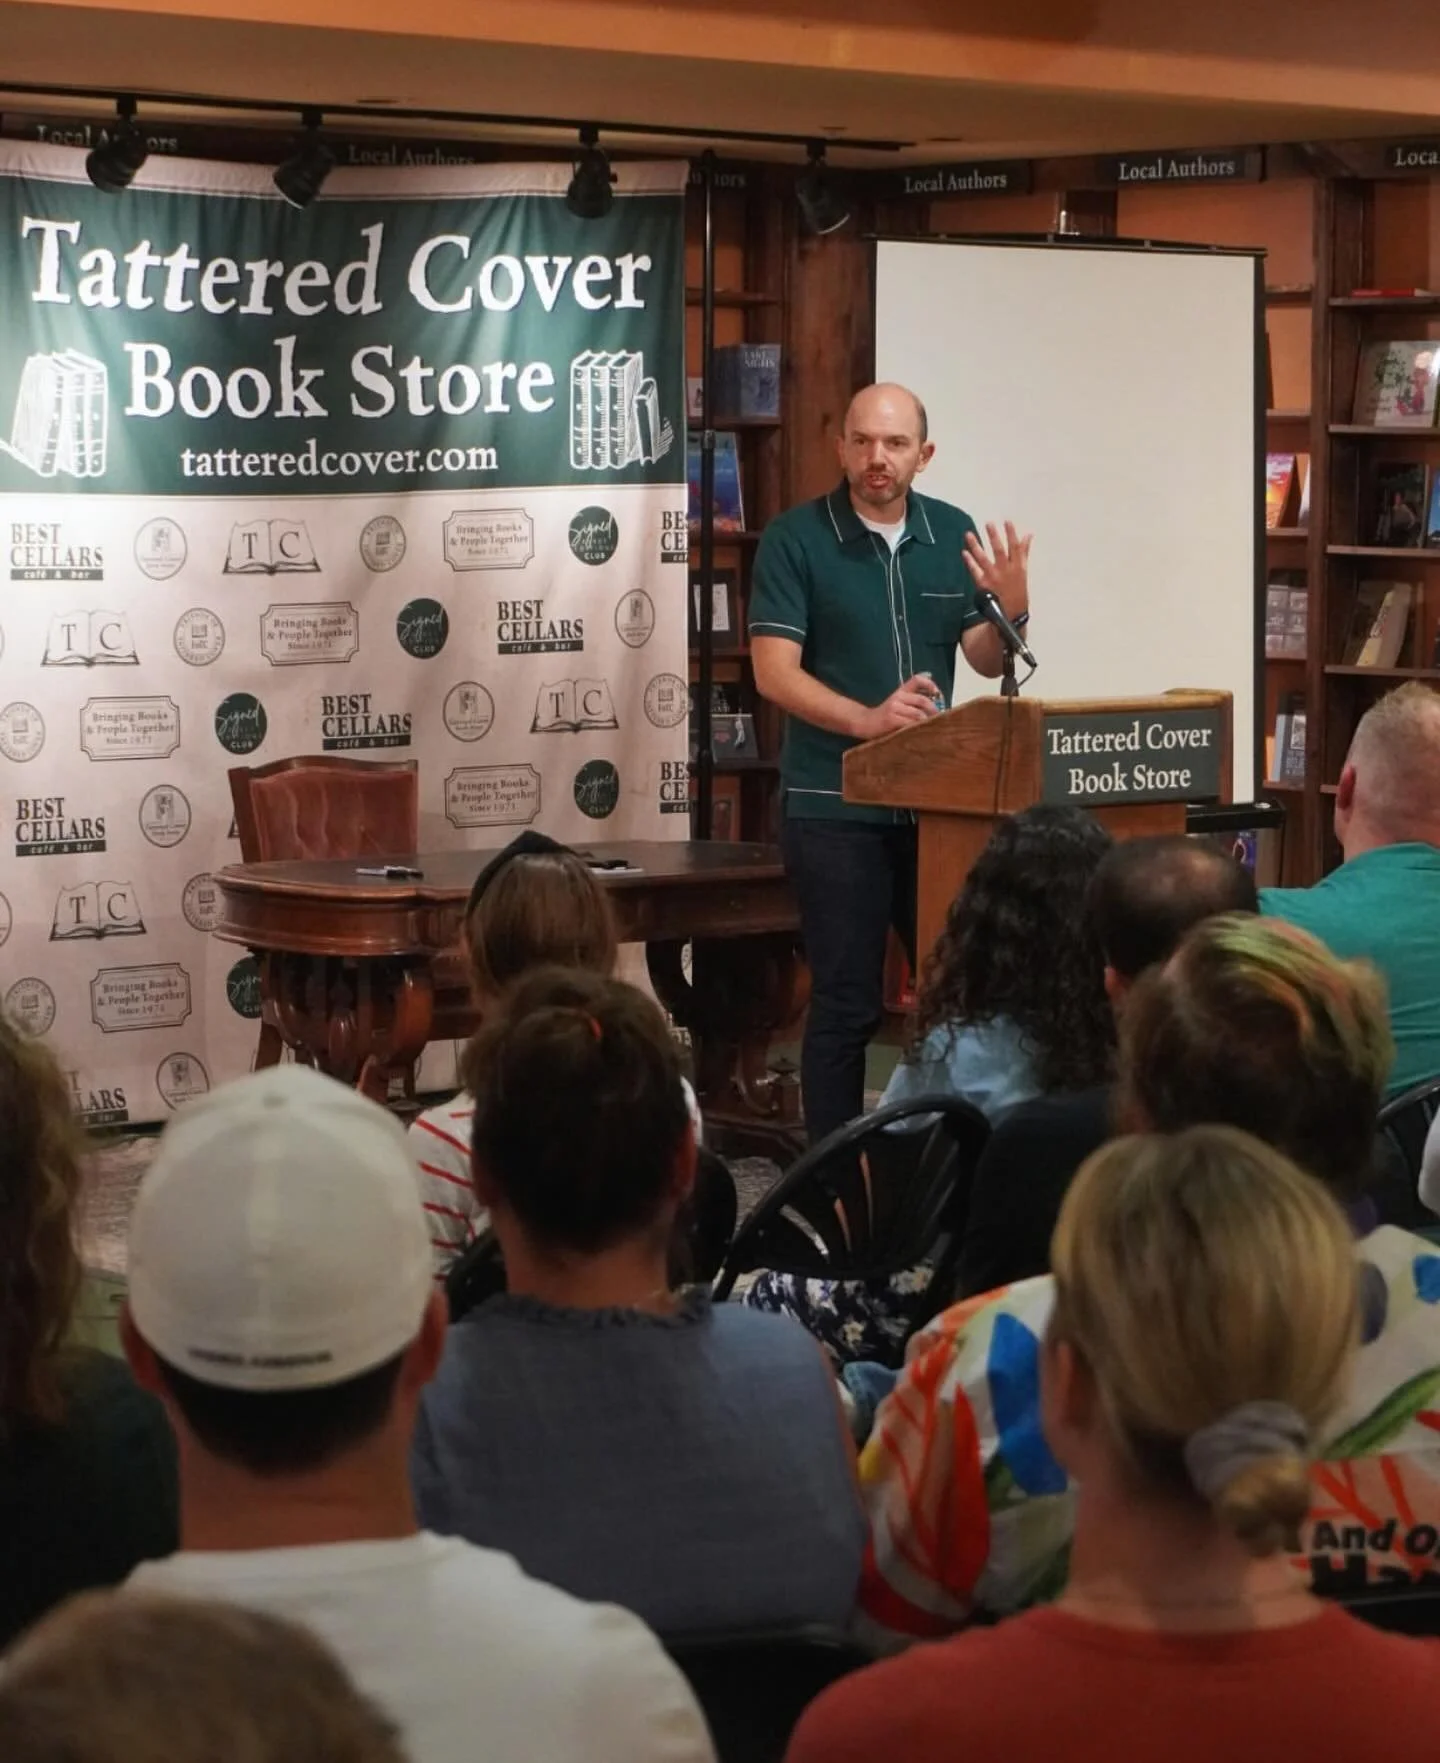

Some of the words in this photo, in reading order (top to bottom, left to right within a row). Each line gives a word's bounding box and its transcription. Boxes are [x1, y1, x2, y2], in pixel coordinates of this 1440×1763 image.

[349, 144, 397, 164] Local
[1119, 158, 1163, 180] Local
[1166, 155, 1235, 178] Authors
[905, 172, 944, 193] Local
[947, 170, 1008, 191] Authors
[21, 215, 385, 316] Tattered
[407, 235, 652, 314] Cover
[123, 335, 329, 420] Book
[350, 343, 556, 419] Store
[180, 440, 499, 478] tatteredcover.com
[11, 523, 61, 545] BEST
[456, 525, 493, 535] Bringing
[11, 547, 104, 567] CELLARS
[242, 532, 257, 560] T
[279, 531, 300, 558] C
[584, 552, 606, 560] CLUB
[497, 600, 544, 620] BEST
[274, 619, 319, 630] Bringing
[497, 619, 584, 642] CELLARS
[61, 624, 76, 651] T
[100, 623, 122, 650] C
[321, 693, 372, 716] BEST
[549, 691, 564, 718] T
[583, 689, 602, 715] C
[93, 711, 135, 723] Bringing
[321, 713, 413, 738] CELLARS
[230, 741, 253, 749] CLUB
[1047, 720, 1140, 755] Tattered
[1146, 723, 1212, 750] Cover
[456, 780, 498, 792] Bringing
[1067, 761, 1128, 795] Book
[1132, 764, 1192, 791] Store
[16, 797, 65, 821] BEST
[16, 817, 106, 842] CELLARS
[69, 895, 86, 924] T
[107, 892, 127, 920] C
[102, 982, 146, 994] Bringing
[76, 1087, 128, 1111] LARS
[1312, 1517, 1397, 1553] And
[1405, 1523, 1440, 1556] O
